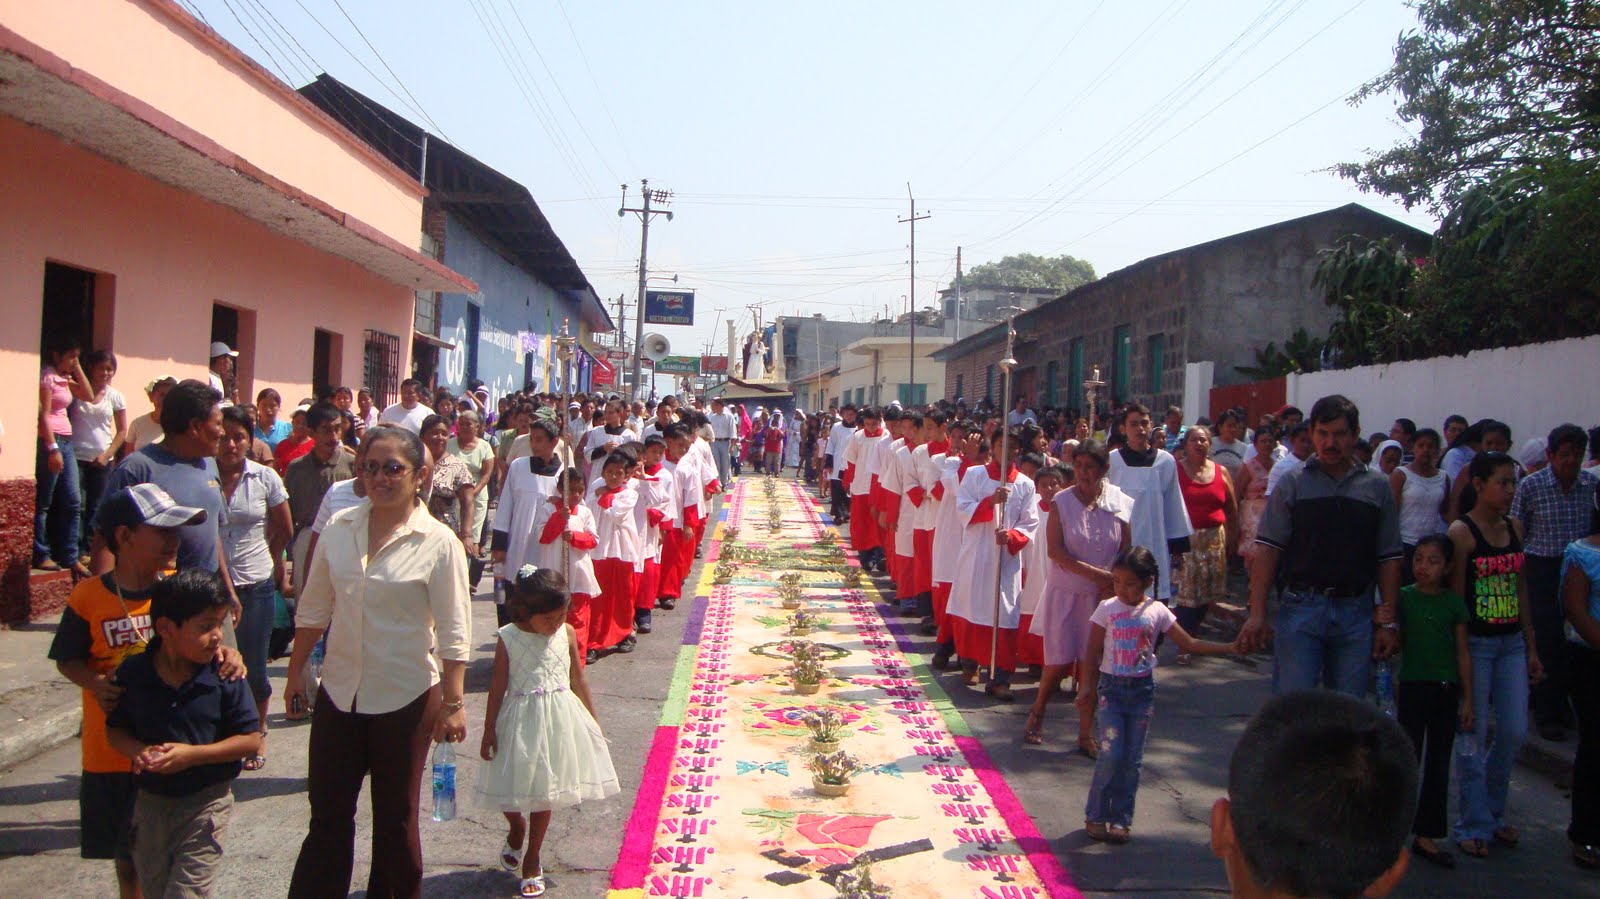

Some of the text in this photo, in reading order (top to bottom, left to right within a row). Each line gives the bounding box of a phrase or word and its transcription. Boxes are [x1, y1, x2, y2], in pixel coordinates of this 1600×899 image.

[656, 294, 684, 302] PEPSI
[1475, 552, 1525, 577] SPRIN
[103, 615, 152, 647] POW
